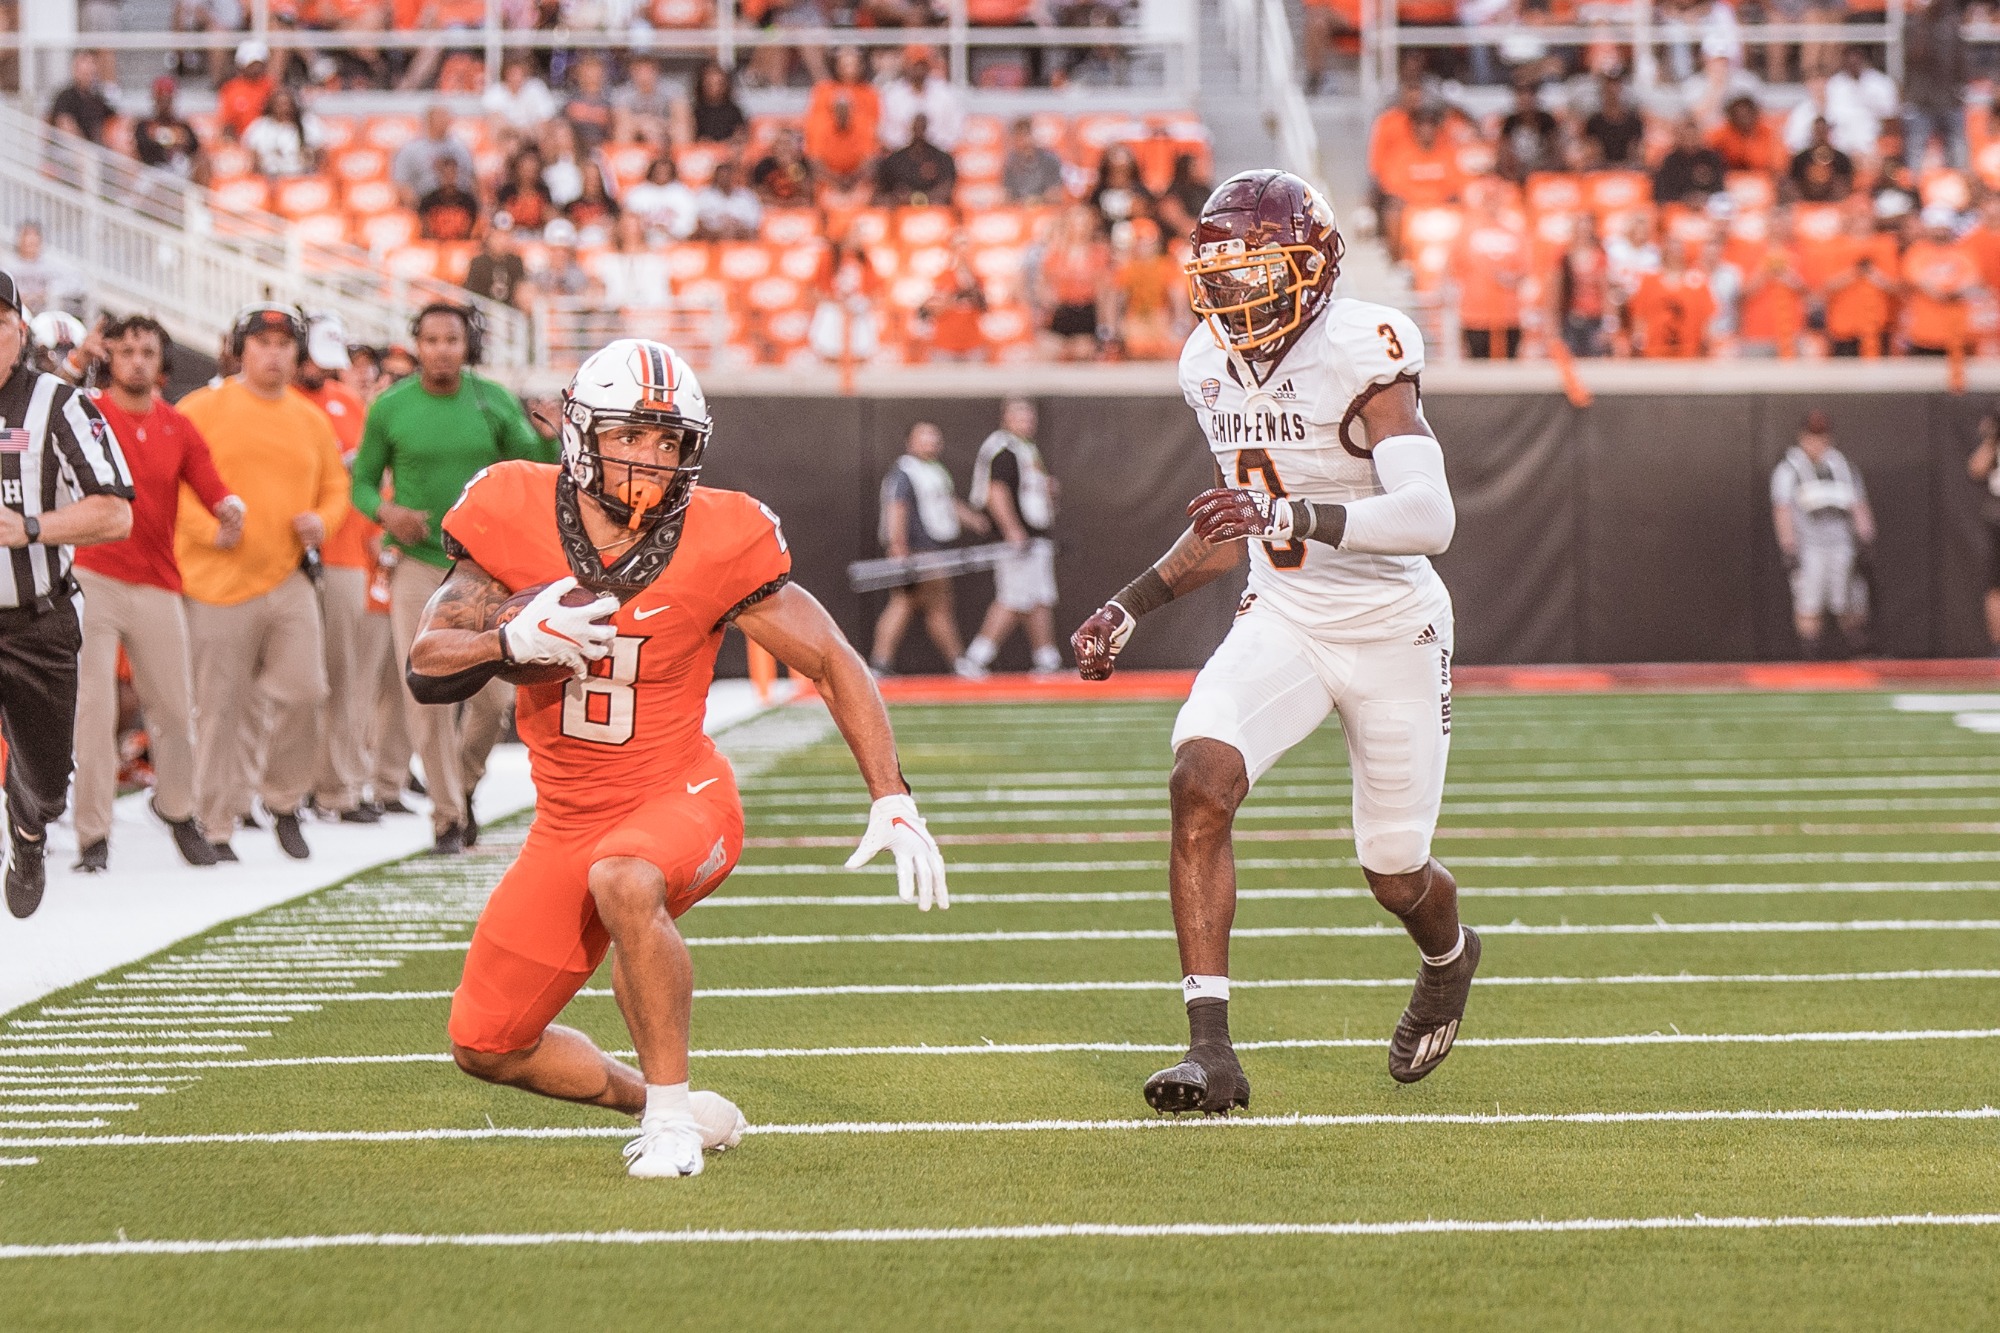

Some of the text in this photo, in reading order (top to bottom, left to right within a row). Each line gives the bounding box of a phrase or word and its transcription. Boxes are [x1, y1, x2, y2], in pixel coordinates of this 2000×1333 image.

[1377, 323, 1403, 361] 3
[2, 479, 22, 504] H
[560, 633, 653, 746] 8
